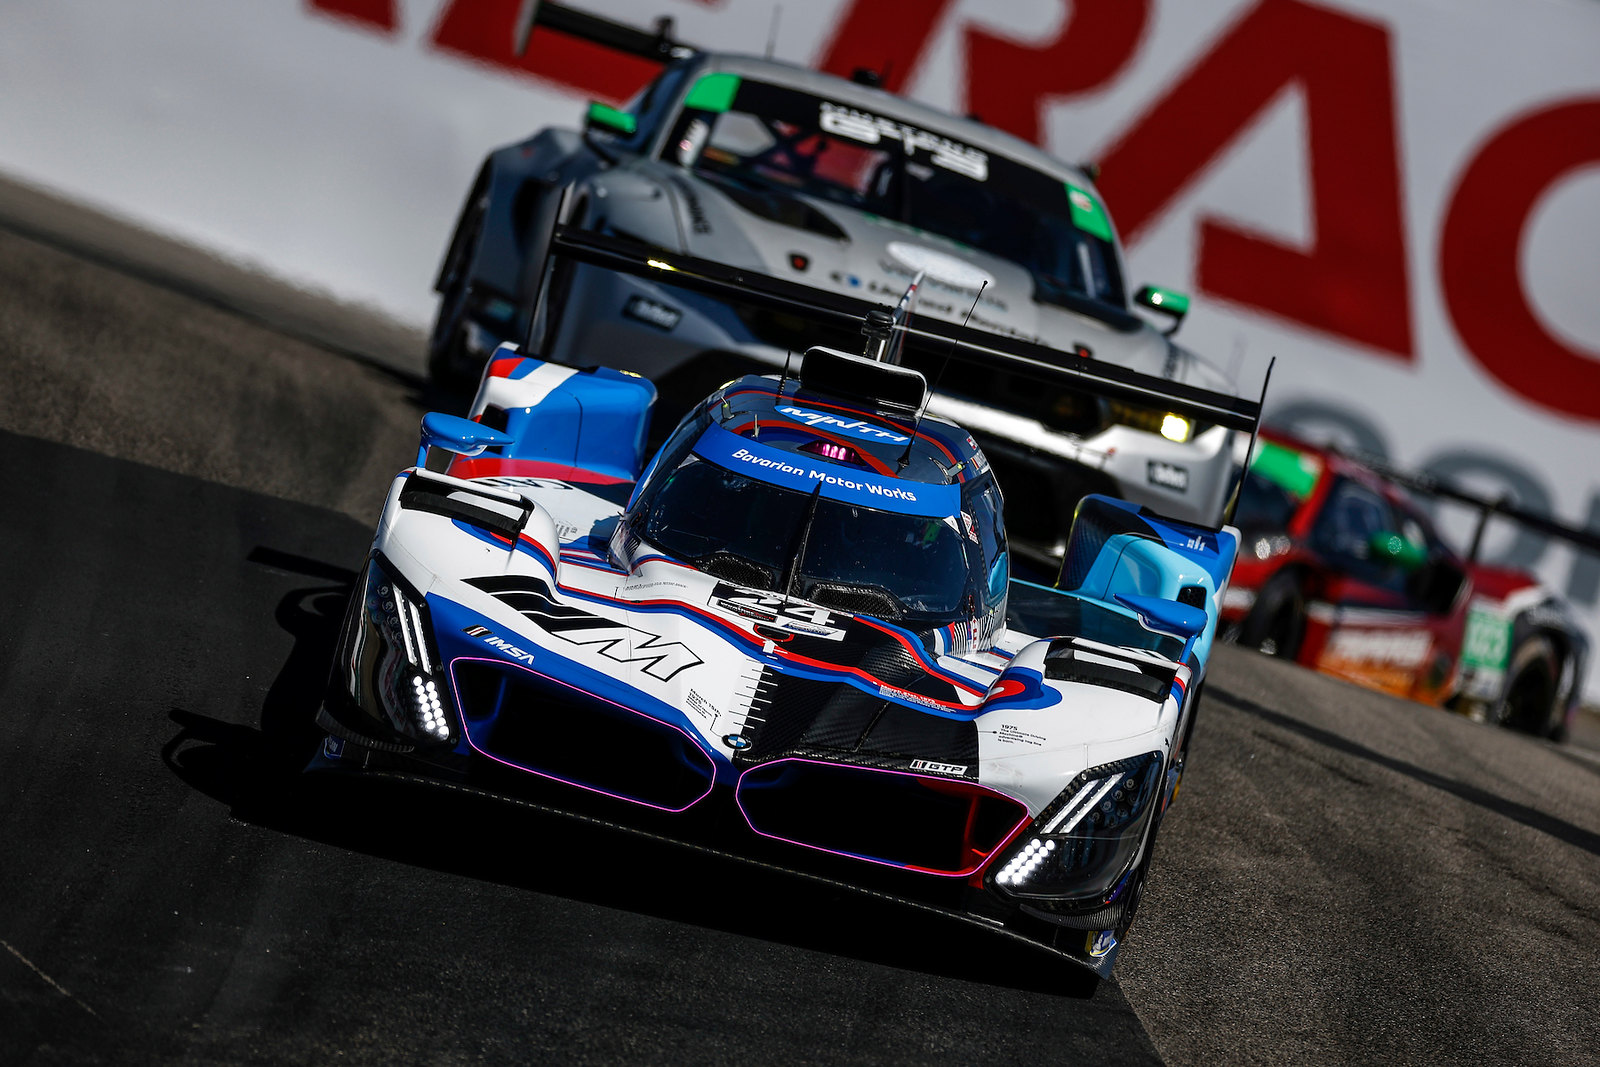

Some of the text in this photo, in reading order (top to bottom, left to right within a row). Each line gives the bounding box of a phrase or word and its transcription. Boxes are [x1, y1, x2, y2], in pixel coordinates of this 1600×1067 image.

[731, 448, 917, 502] Bavarian Motor Works
[727, 588, 836, 626] 24
[483, 636, 535, 666] IMSA
[928, 763, 963, 772] GTP
